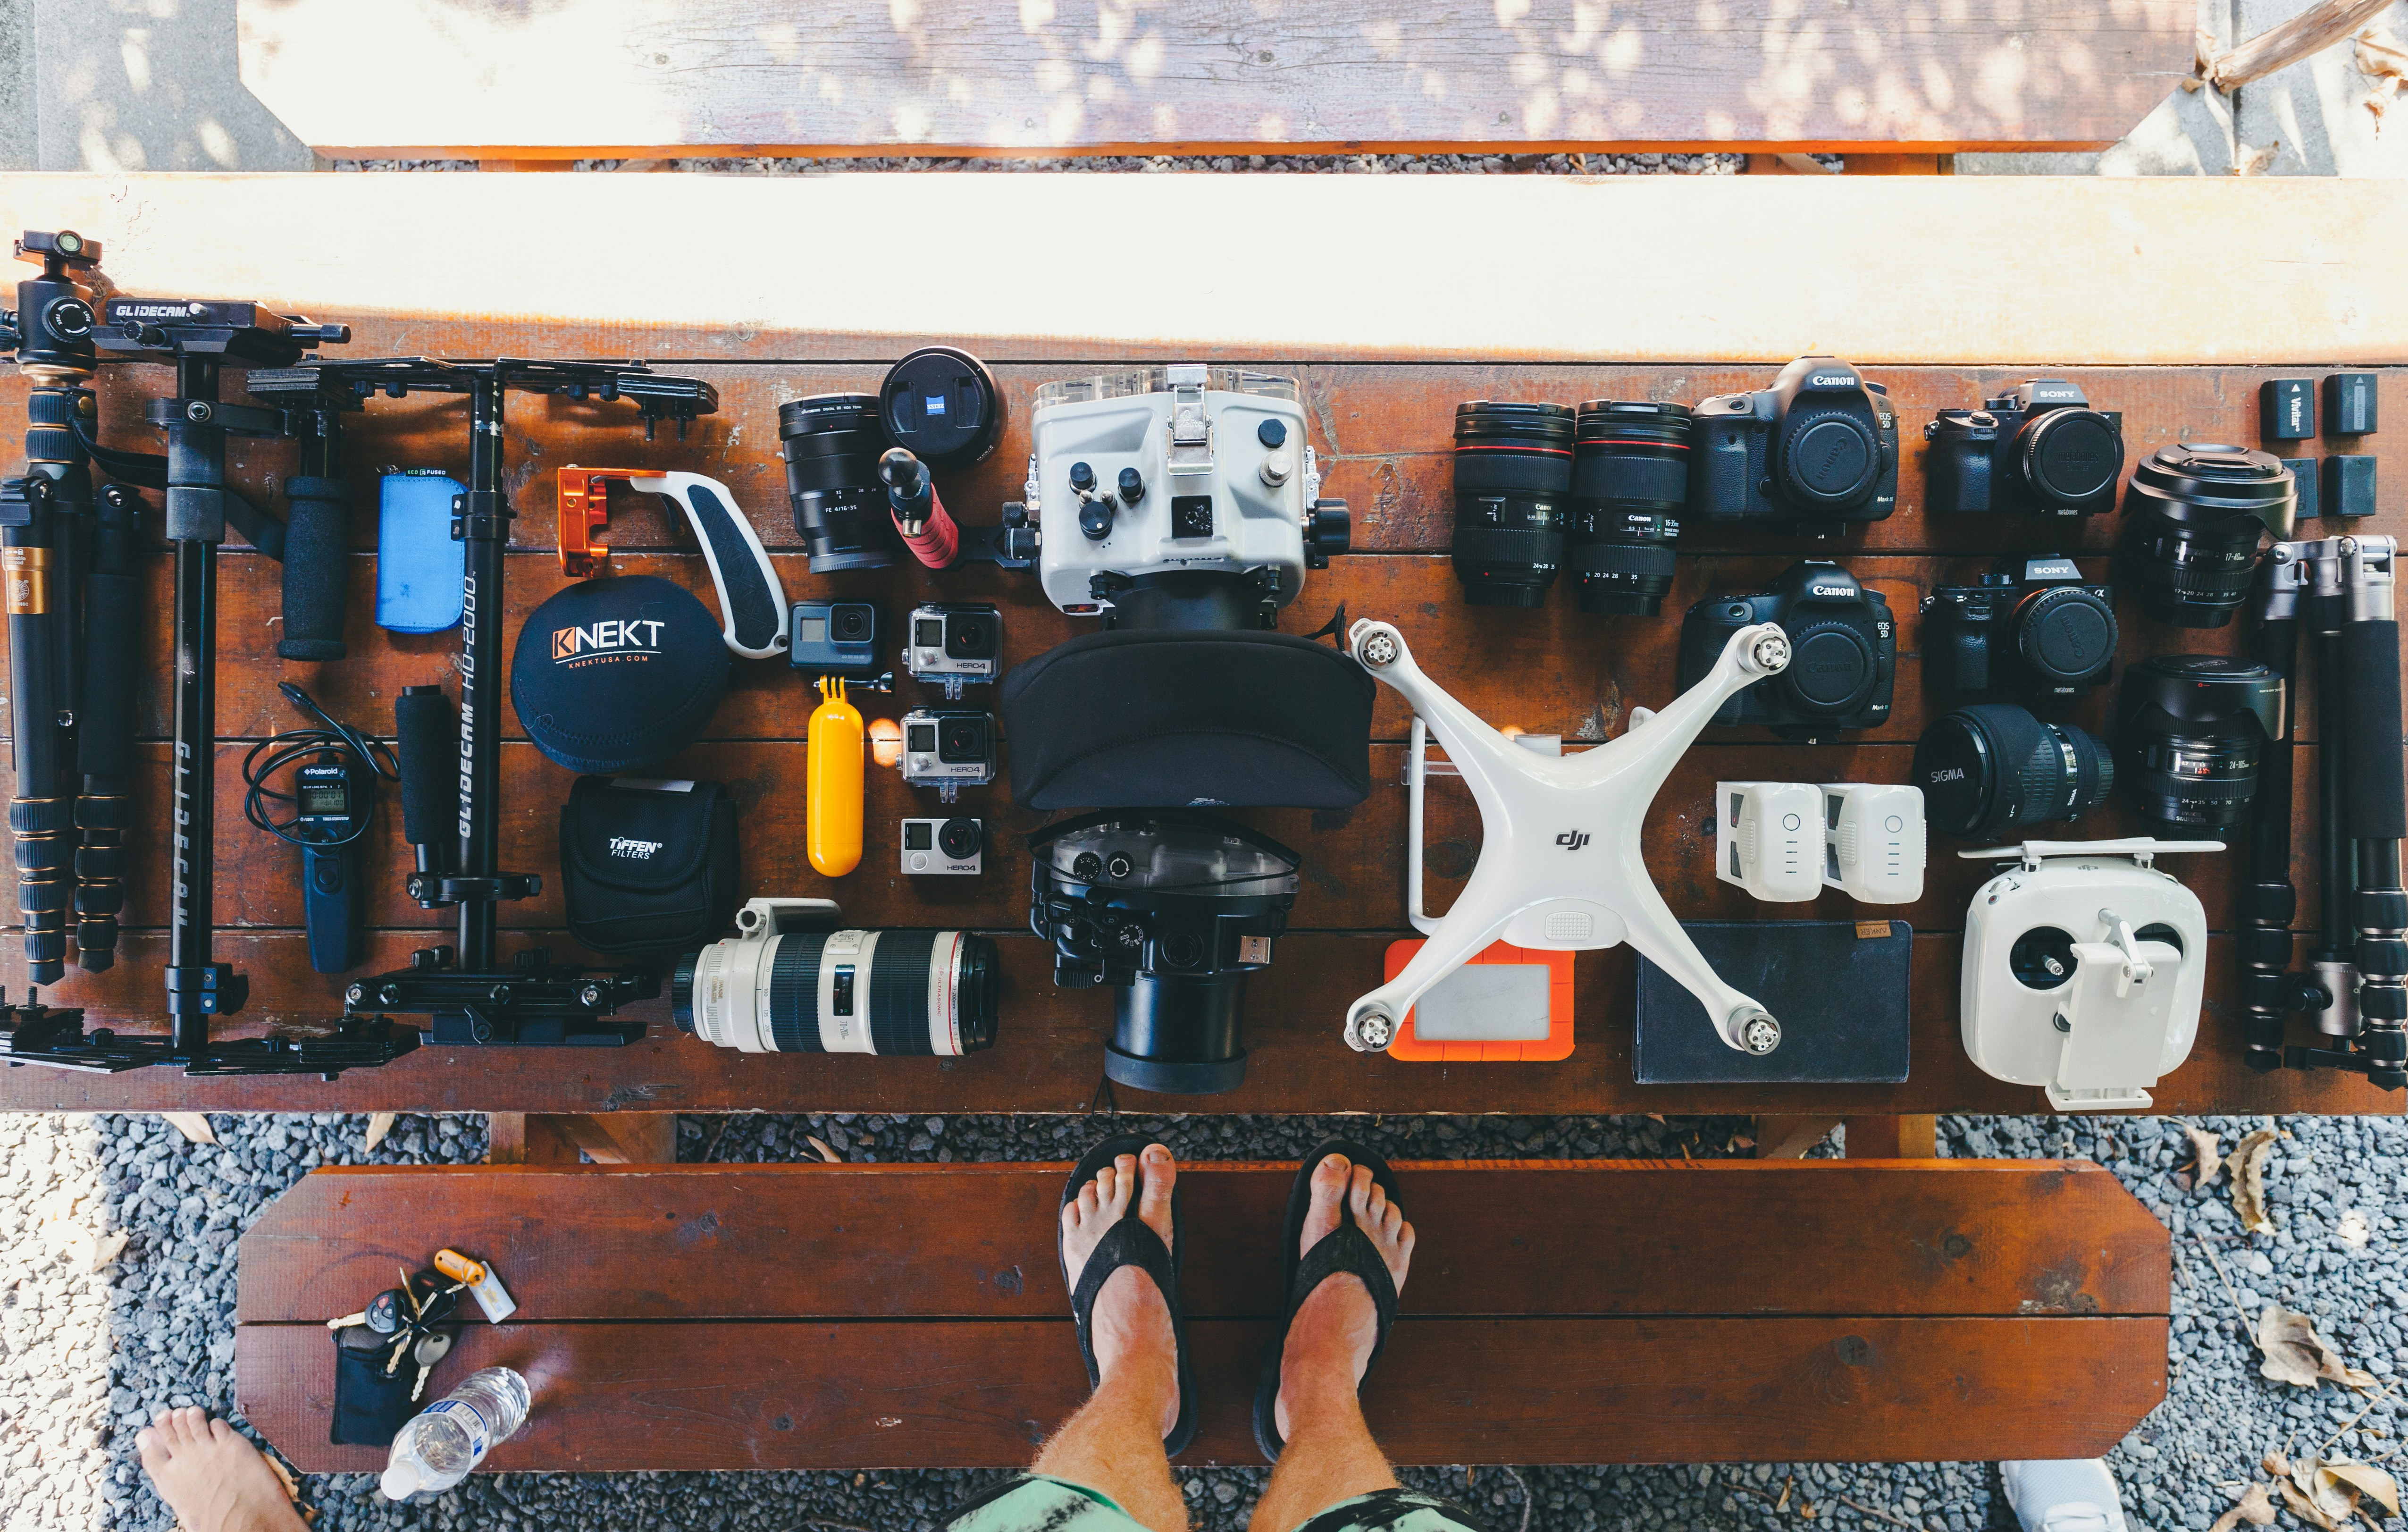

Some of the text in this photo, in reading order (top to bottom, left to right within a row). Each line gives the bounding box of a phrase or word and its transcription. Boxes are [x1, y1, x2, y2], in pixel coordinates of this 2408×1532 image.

[83, 311, 91, 322] LOCK
[116, 305, 187, 317] GLIDECAM
[55, 314, 63, 325] FREE
[1812, 376, 1854, 386] Canon
[1879, 412, 1891, 421] EOS
[2291, 397, 2301, 429] Vivitar
[1817, 437, 1847, 480] Canon
[2057, 451, 2099, 463] metabones
[1812, 586, 1854, 597] Canon
[1877, 622, 1890, 630] EOS
[552, 620, 665, 660] KNEKT
[2060, 614, 2085, 659] Canon
[569, 655, 648, 669] KNEKTUSA.COM
[459, 575, 476, 838] GLIDECAM HD-2000
[1930, 767, 1964, 783] SIGMA
[2067, 789, 2077, 806] SIGMA
[173, 740, 191, 926] GLIDECAM
[1556, 830, 1591, 850] dji
[611, 849, 650, 859] FILTERS
